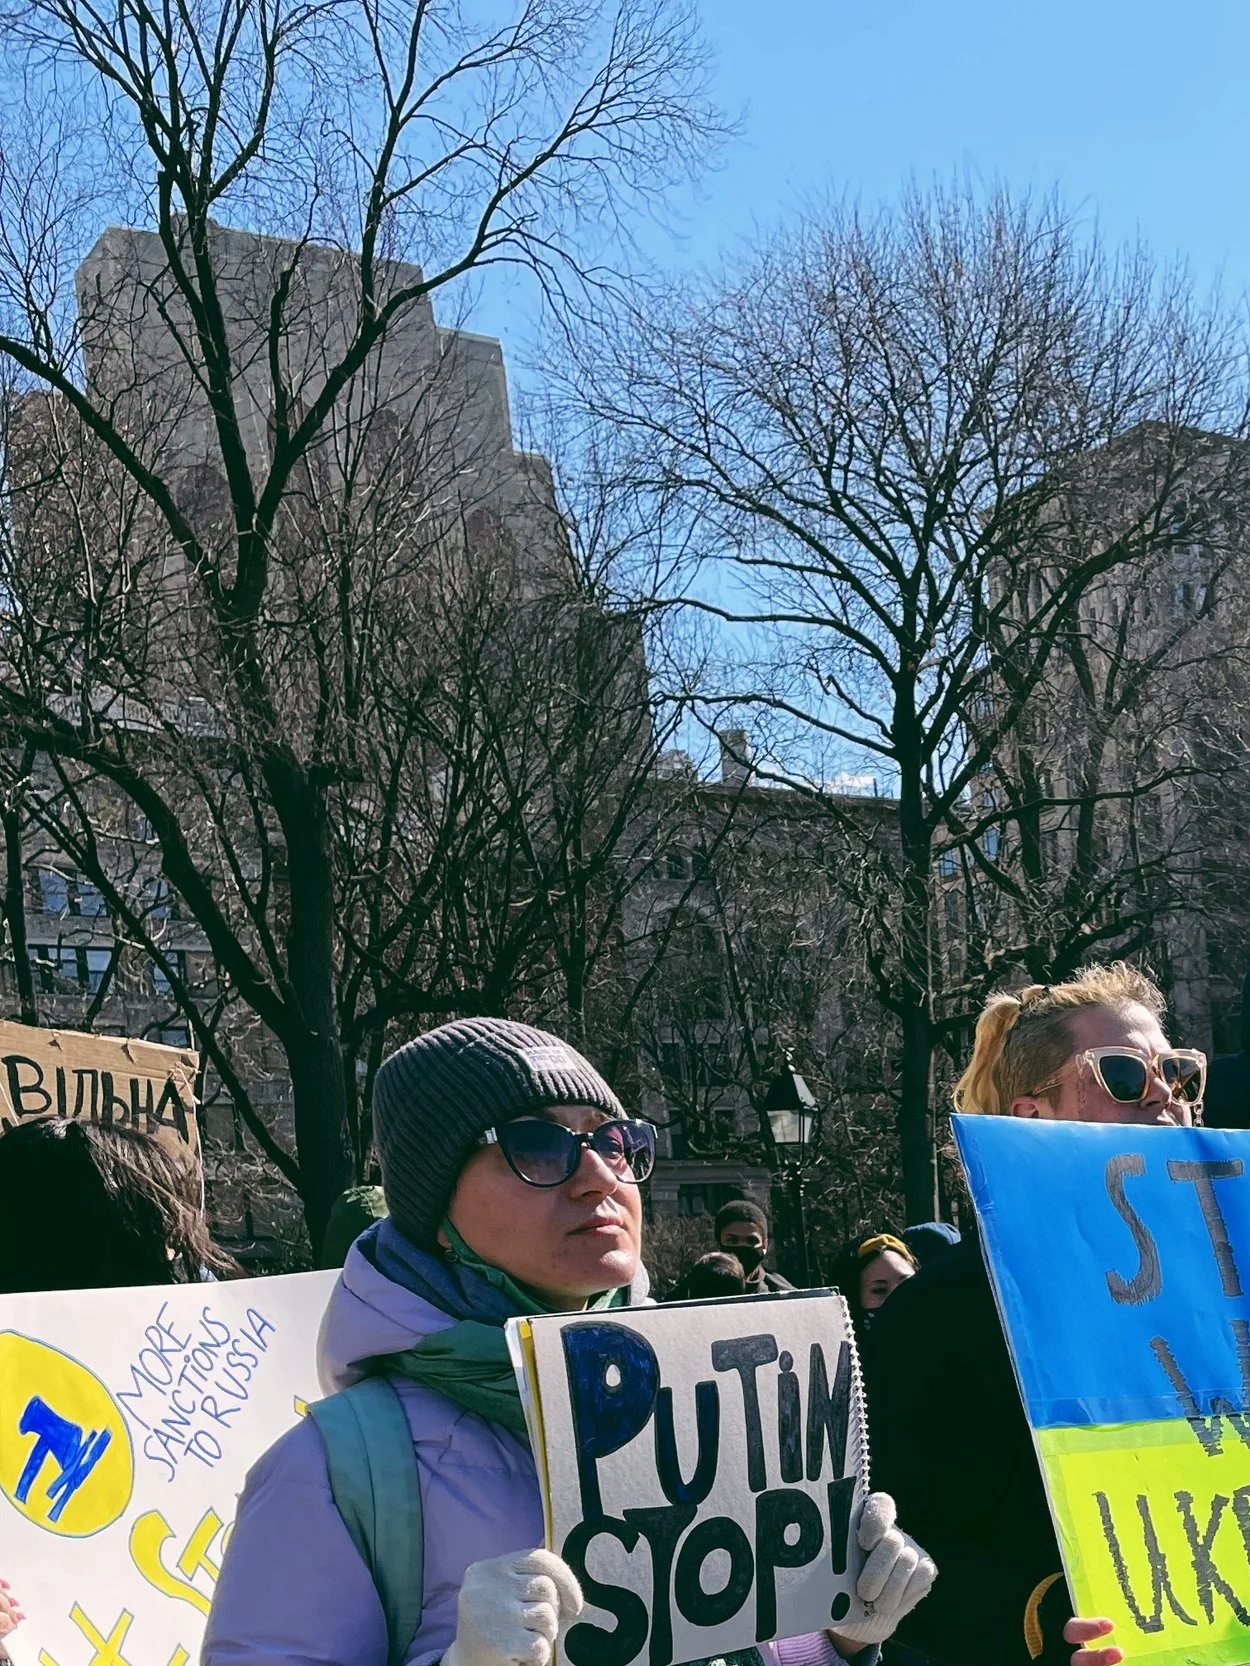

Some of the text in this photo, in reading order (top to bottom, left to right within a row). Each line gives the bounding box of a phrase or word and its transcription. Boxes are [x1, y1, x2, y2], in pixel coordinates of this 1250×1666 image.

[115, 1301, 192, 1430] MORE
[183, 1308, 276, 1469] TO RUSSIA
